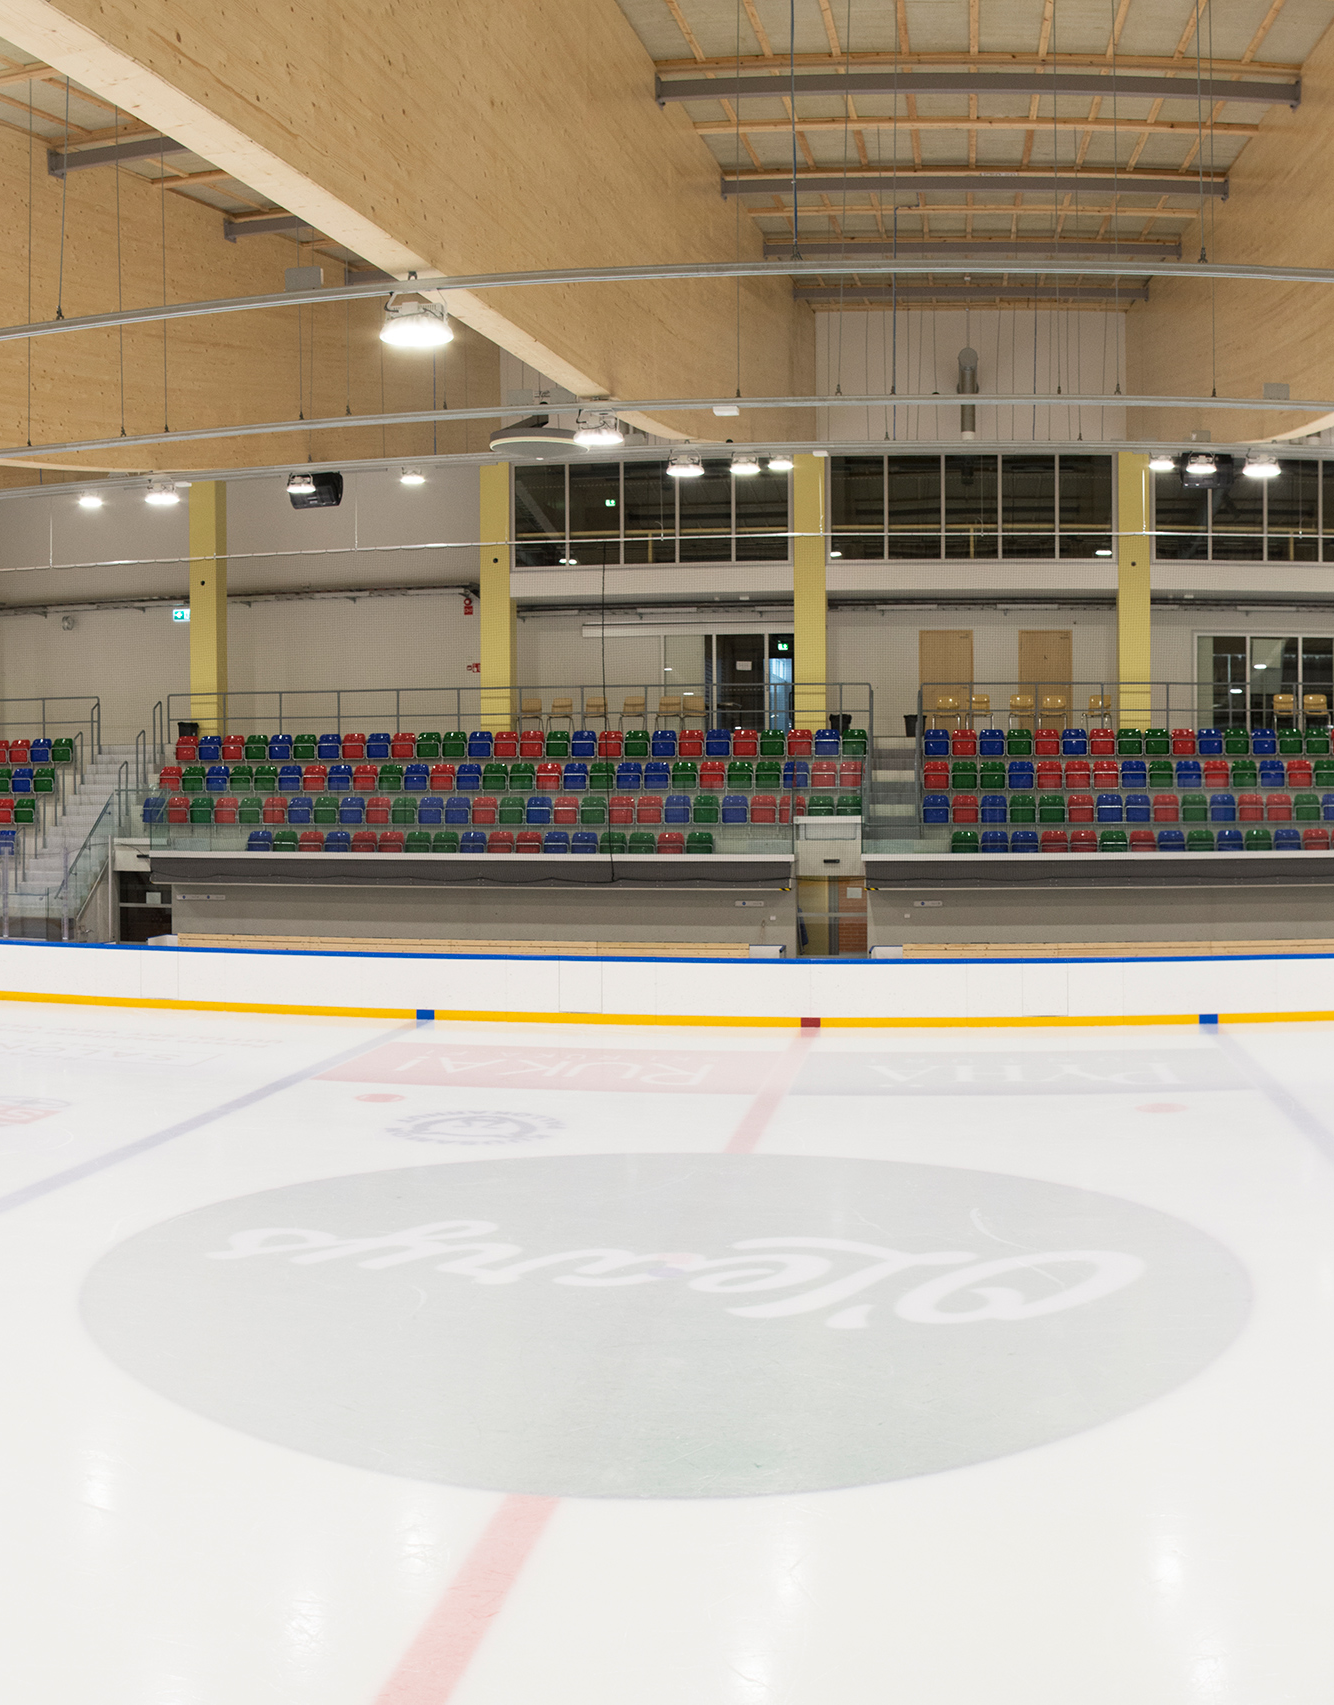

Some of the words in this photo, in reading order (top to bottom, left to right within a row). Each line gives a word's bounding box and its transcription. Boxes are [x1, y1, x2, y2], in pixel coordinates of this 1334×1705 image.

[394, 1057, 717, 1086] RUKA!
[868, 1063, 1185, 1088] PYHÄ
[206, 1220, 1145, 1328] O'Learys
